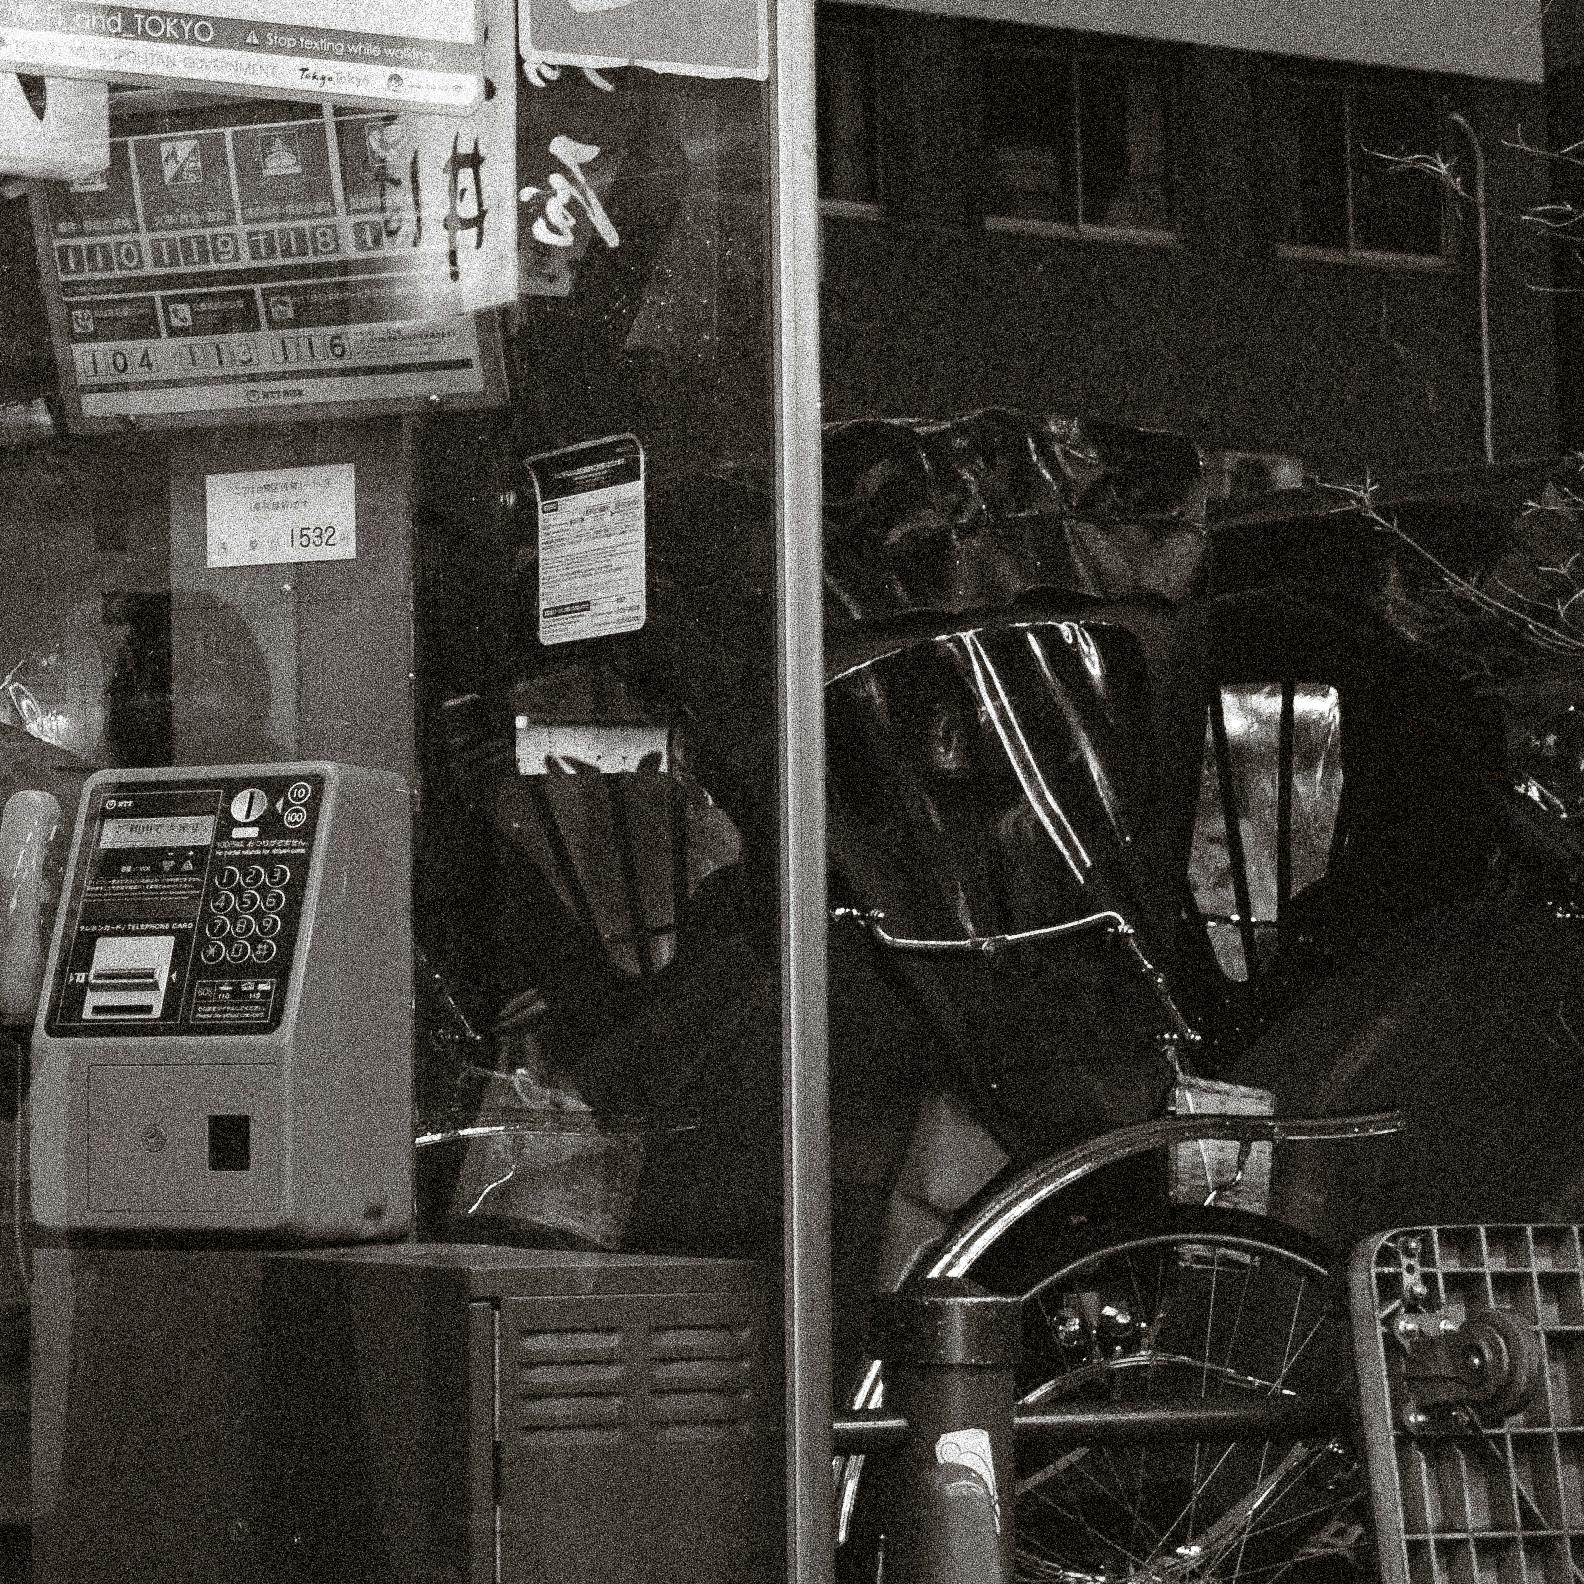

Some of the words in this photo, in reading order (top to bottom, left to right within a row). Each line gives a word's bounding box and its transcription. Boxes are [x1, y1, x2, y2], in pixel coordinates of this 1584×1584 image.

[265, 31, 298, 53] Stop
[90, 346, 154, 376] 104
[289, 524, 337, 549] 1532
[171, 921, 194, 930] CARD
